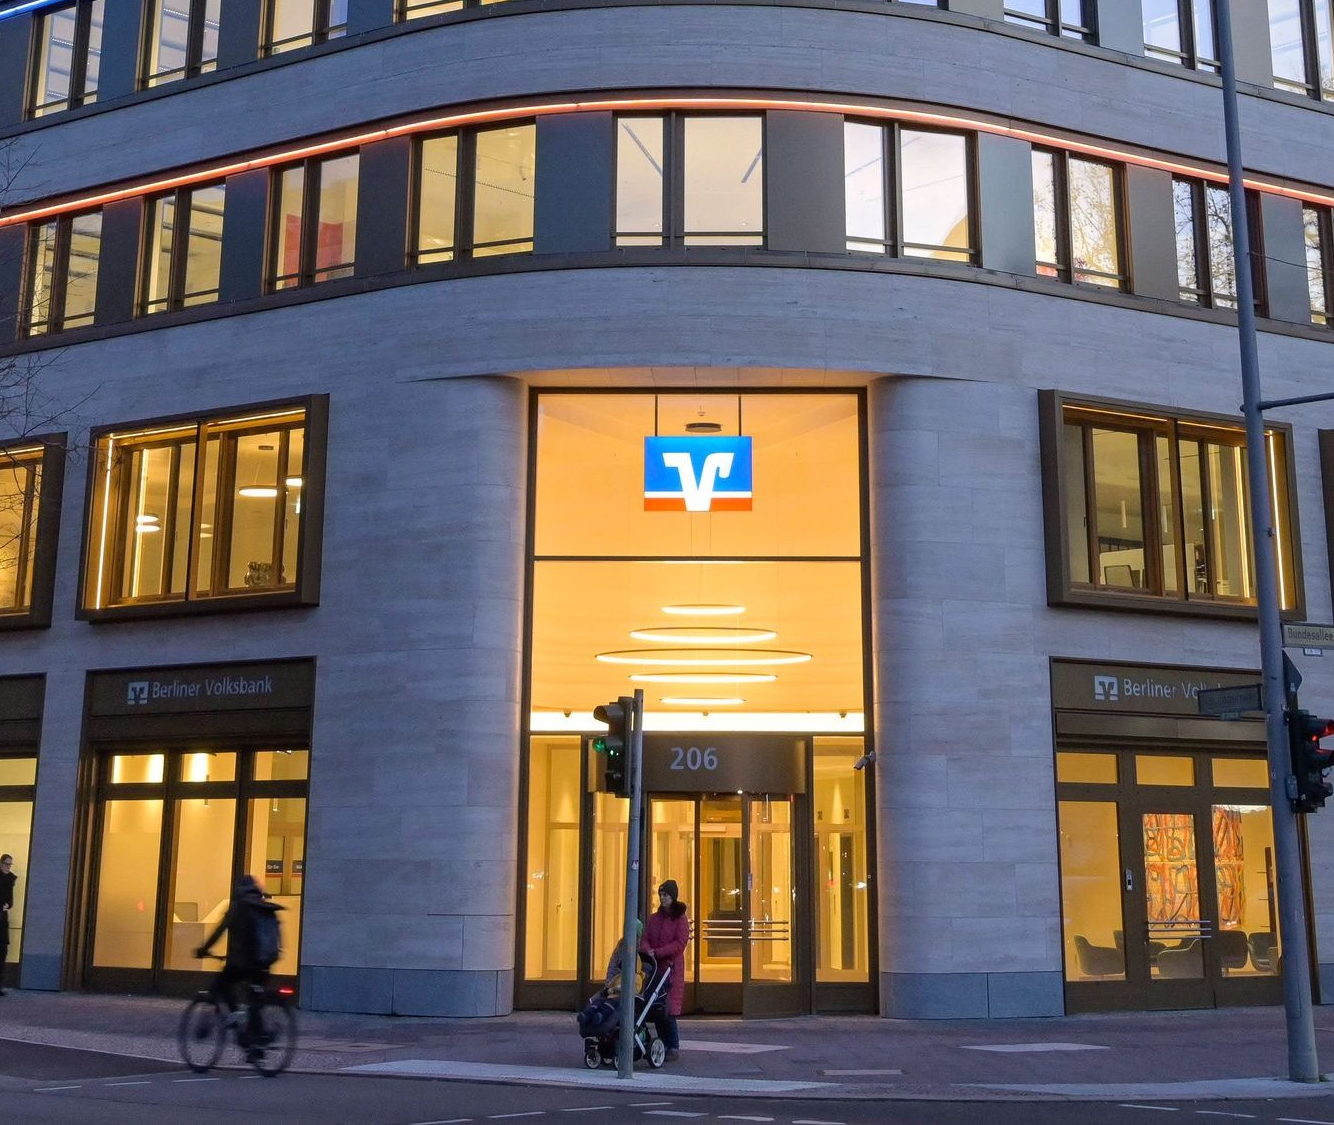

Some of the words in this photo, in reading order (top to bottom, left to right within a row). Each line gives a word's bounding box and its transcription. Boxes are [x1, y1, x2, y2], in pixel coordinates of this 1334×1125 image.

[152, 680, 201, 699] Berliner
[205, 676, 273, 696] Volksbank
[1123, 678, 1177, 699] Berliner
[670, 746, 718, 771] 206
